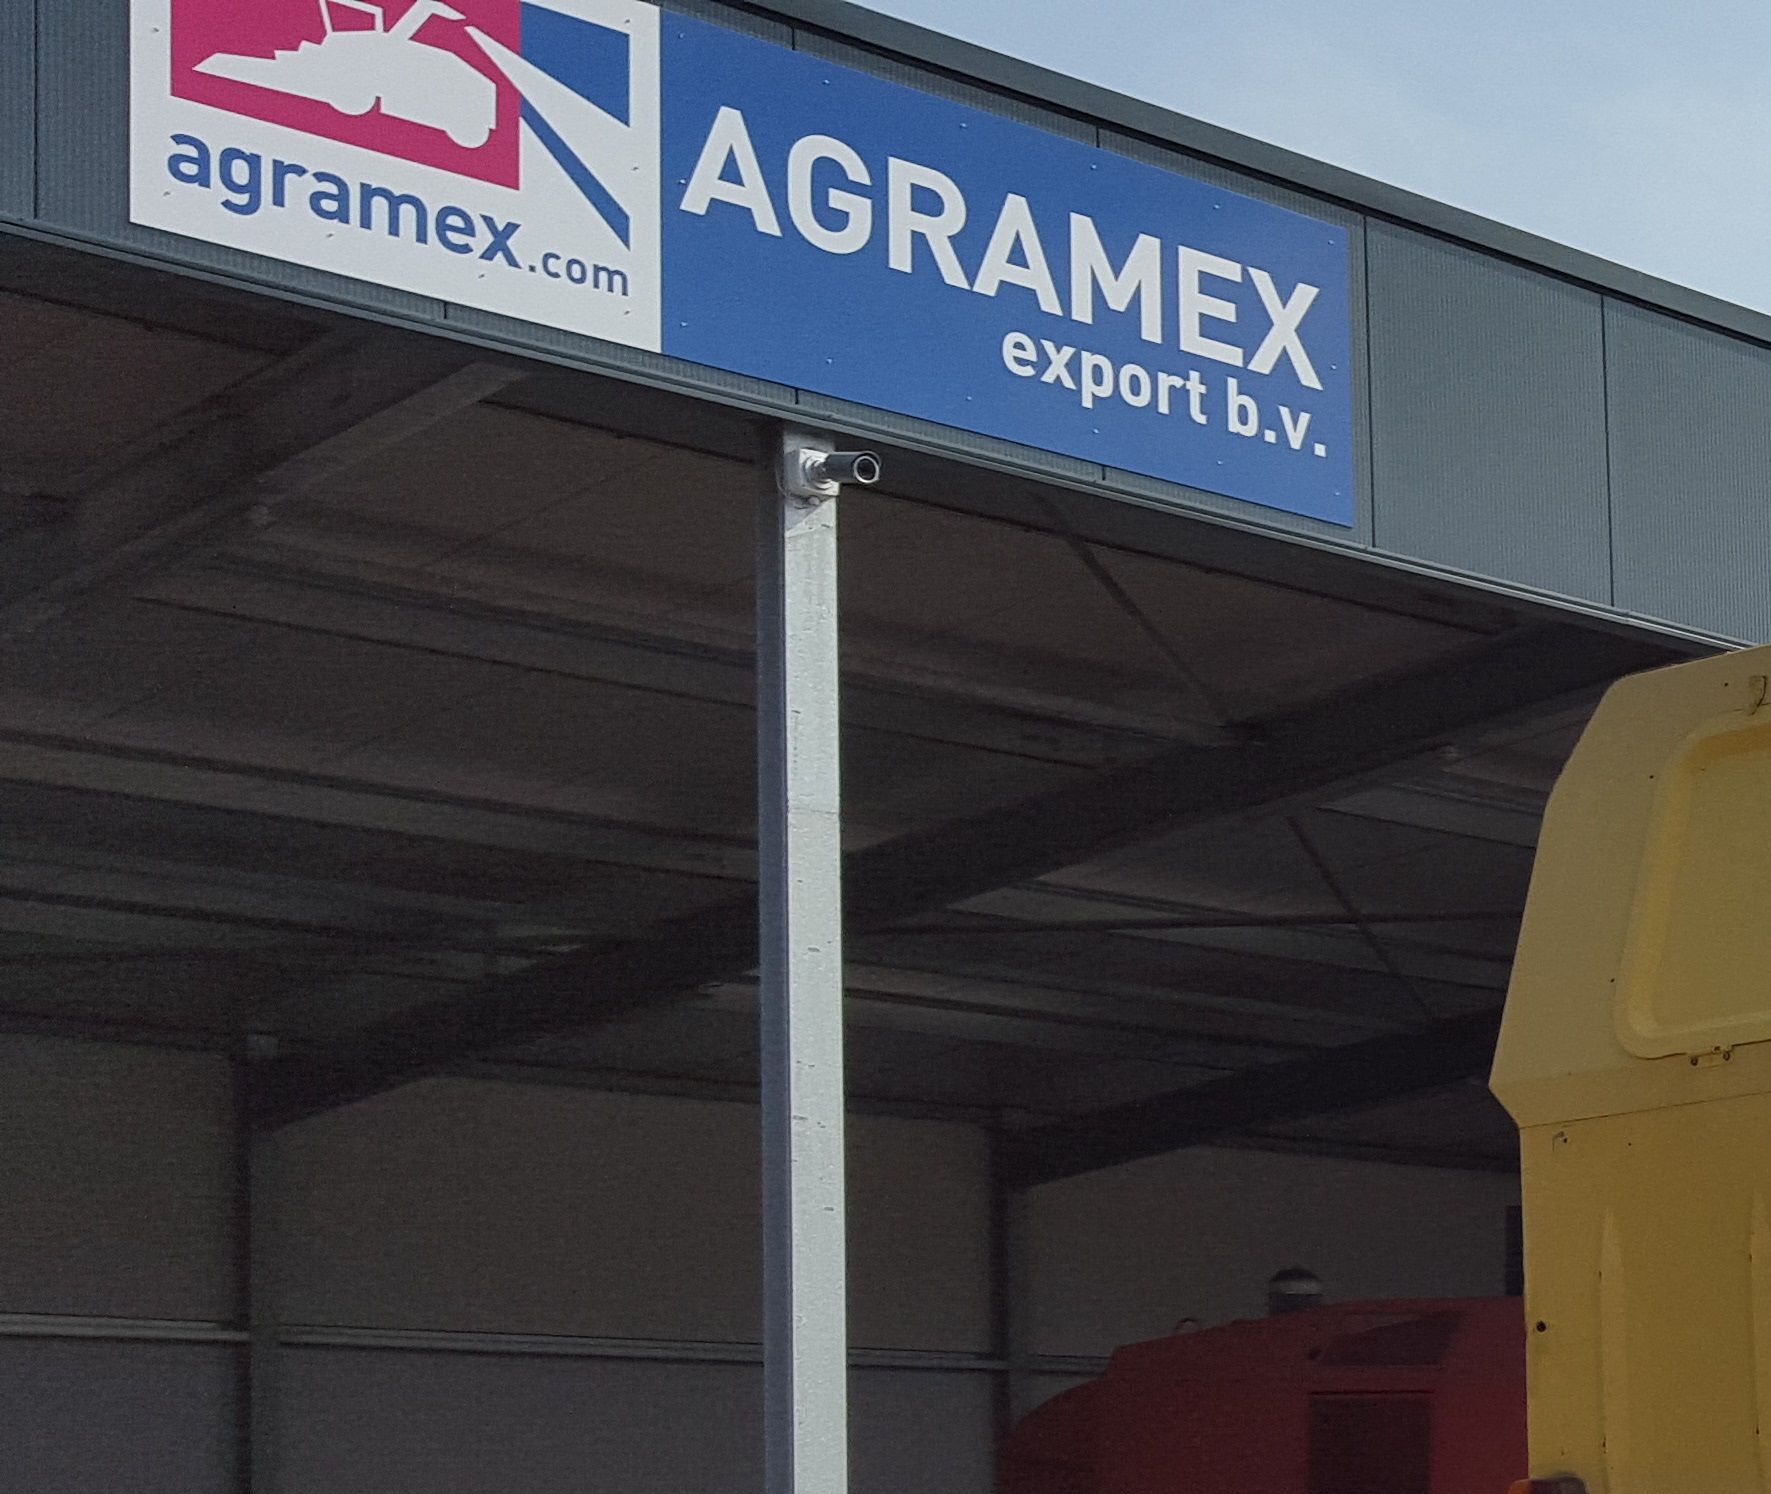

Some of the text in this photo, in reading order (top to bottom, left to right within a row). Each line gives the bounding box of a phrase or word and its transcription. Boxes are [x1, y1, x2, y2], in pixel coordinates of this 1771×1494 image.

[166, 132, 630, 297] agramex.com
[680, 105, 1324, 391] AGRAMEX
[1001, 330, 1328, 458] export b.v.
